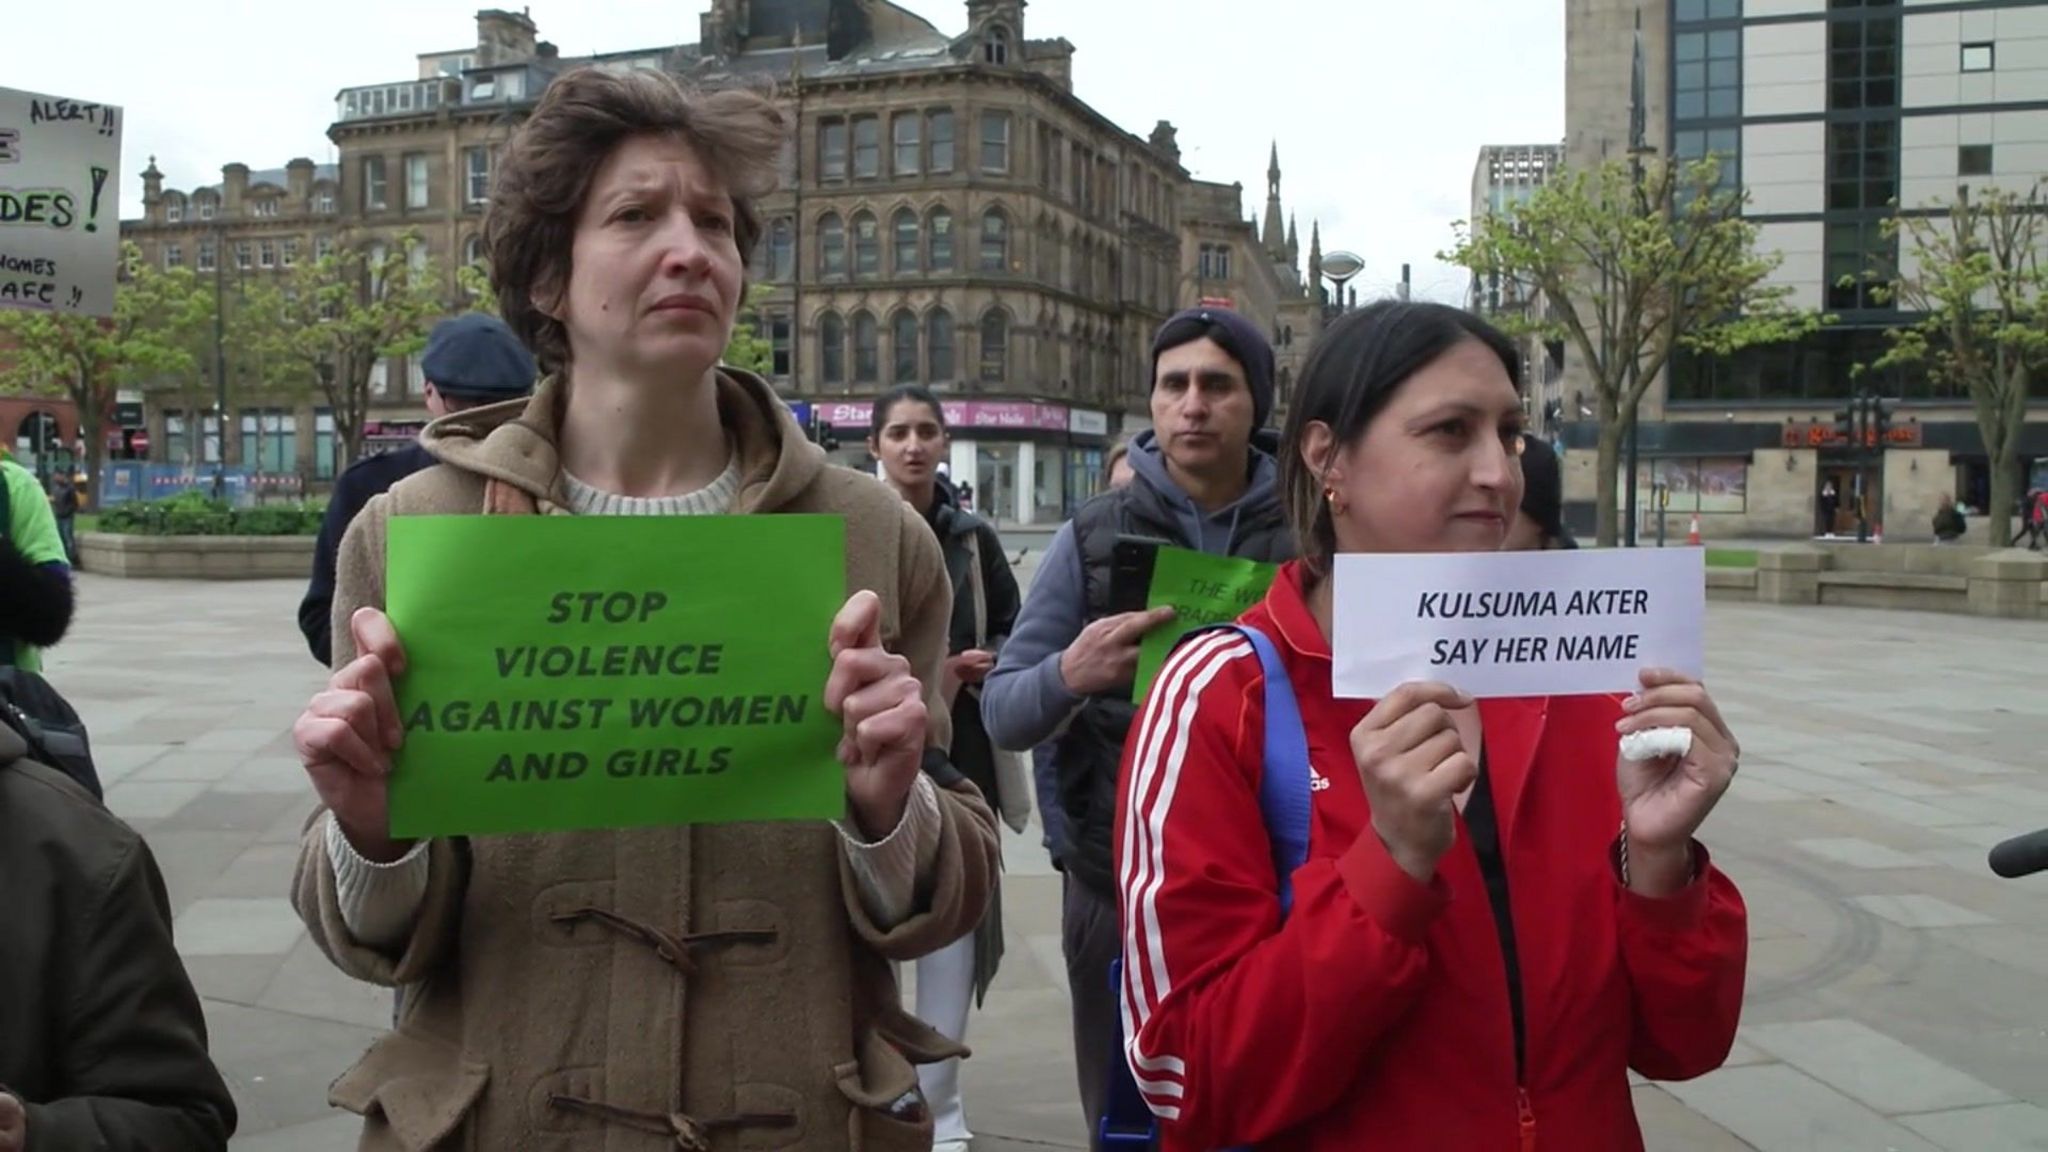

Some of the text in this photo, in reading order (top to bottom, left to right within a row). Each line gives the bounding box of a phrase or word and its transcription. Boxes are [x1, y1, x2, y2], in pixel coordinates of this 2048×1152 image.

[1189, 578, 1230, 600] THE
[1417, 589, 1648, 619] KULSUMA AKTER
[546, 591, 668, 625] STOP
[495, 644, 723, 678] VIOLENCE
[1430, 634, 1640, 665] SAY HER NAME
[406, 695, 809, 734] AGAINST WOMEN
[484, 746, 733, 783] AND GIRLS
